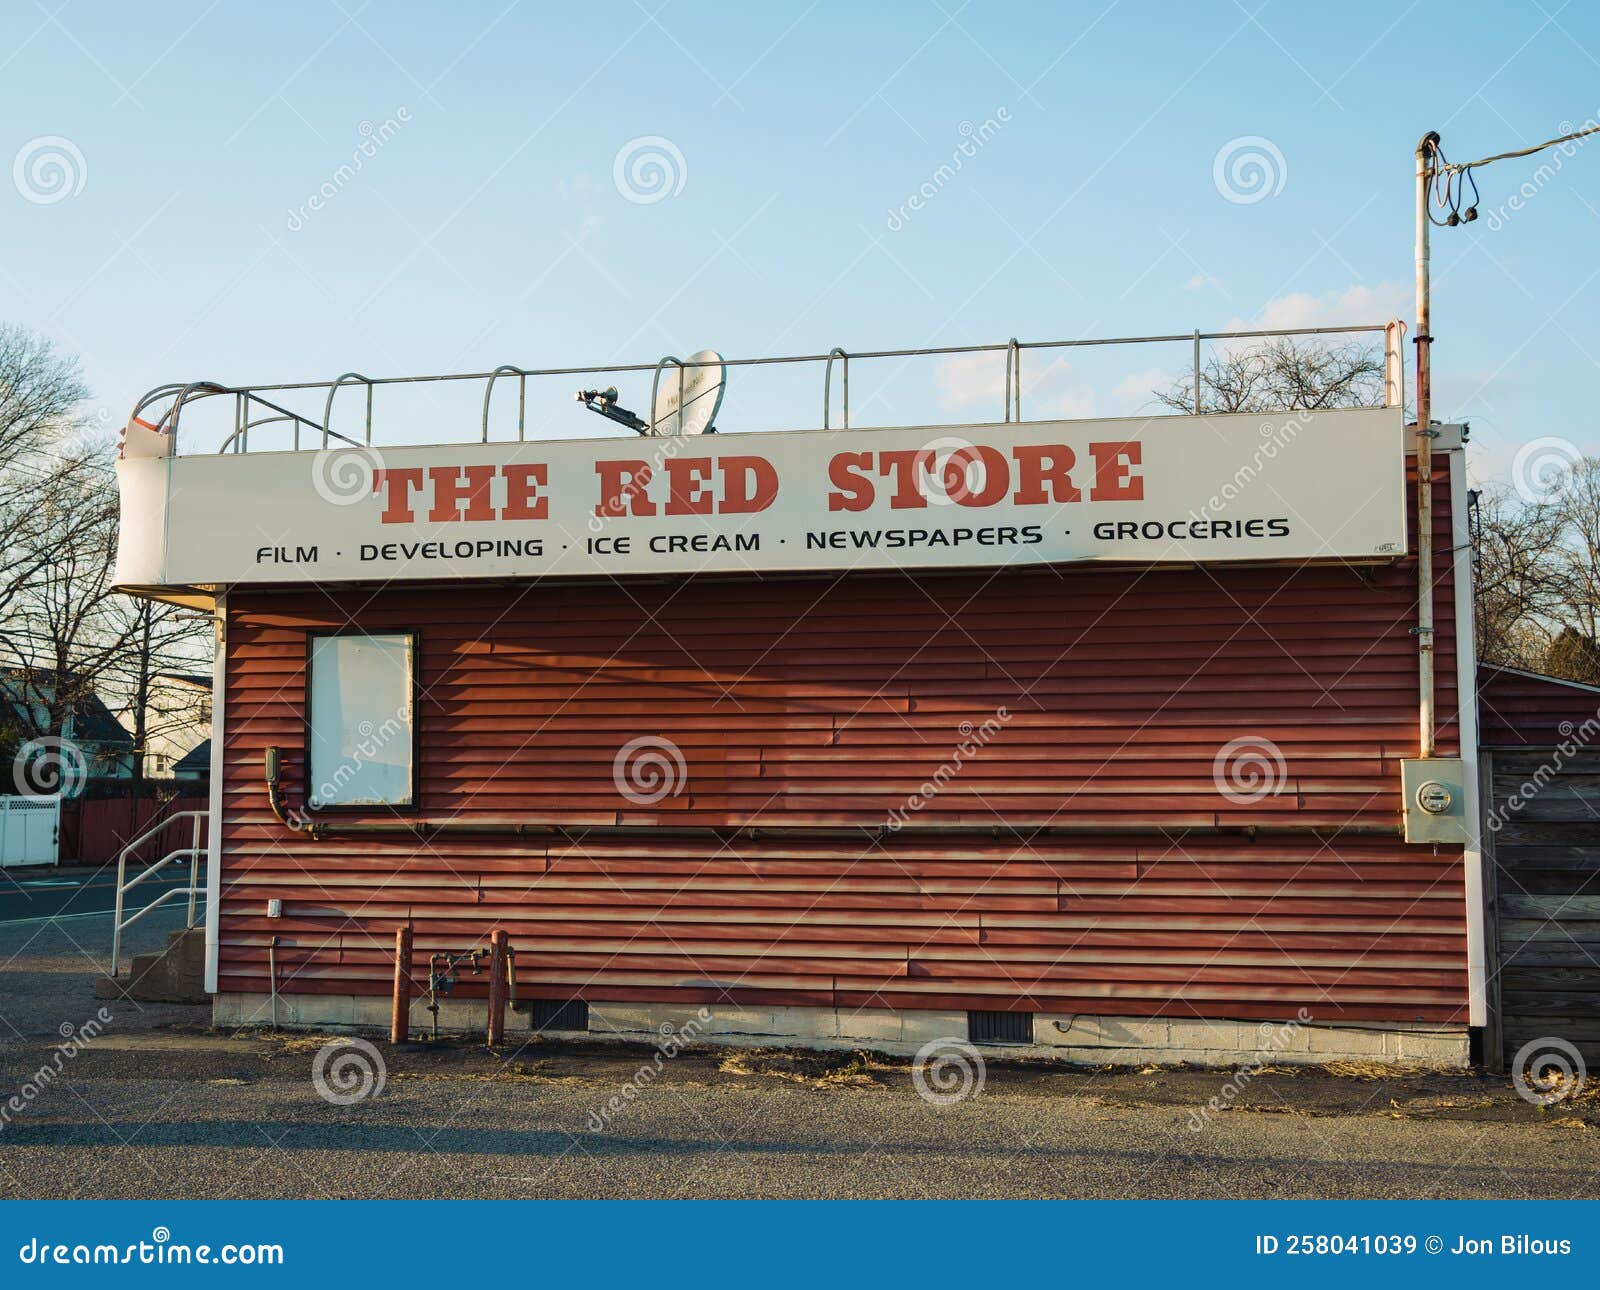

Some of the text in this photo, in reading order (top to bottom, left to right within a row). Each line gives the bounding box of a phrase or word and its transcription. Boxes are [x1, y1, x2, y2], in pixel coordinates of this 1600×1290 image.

[372, 441, 1144, 524] THE RED STORE
[256, 518, 1290, 564] FILM DEVELOPING ICE CREAM NEWSPAPERS GROCERIES
